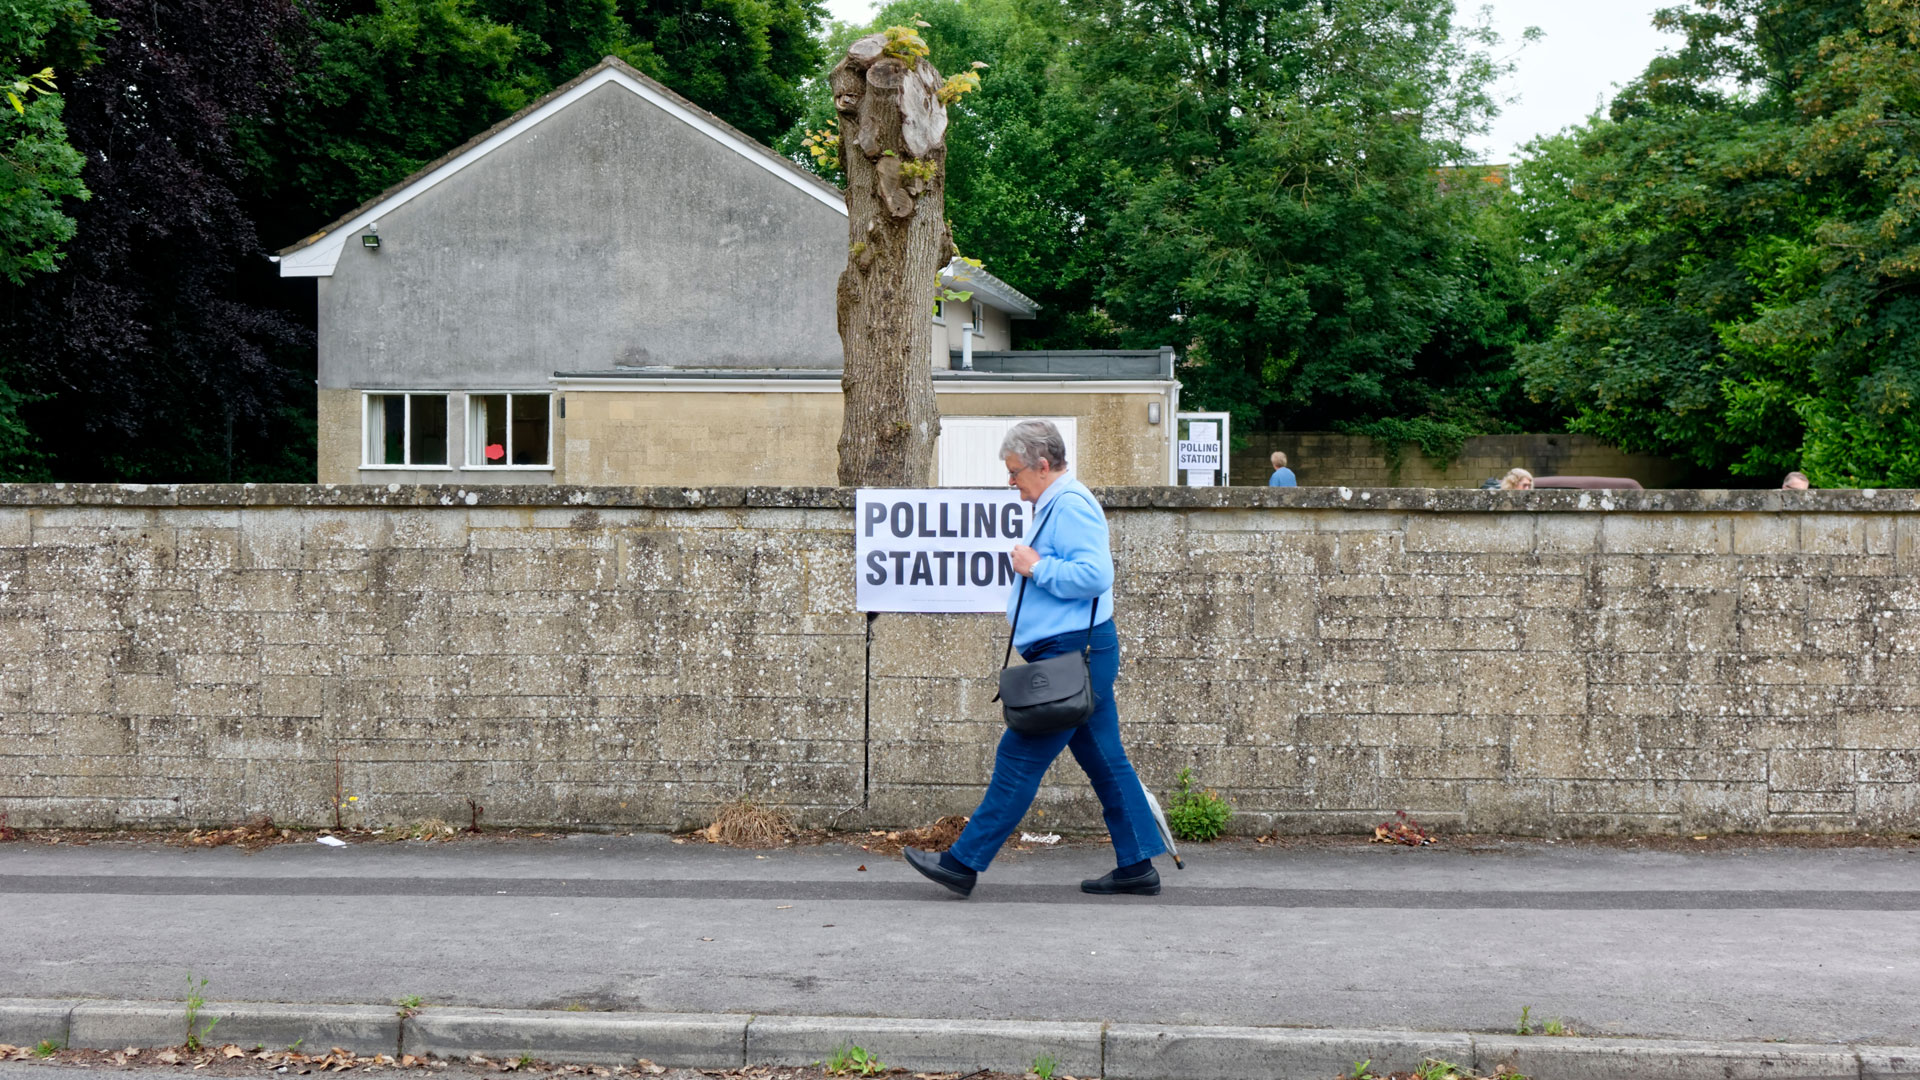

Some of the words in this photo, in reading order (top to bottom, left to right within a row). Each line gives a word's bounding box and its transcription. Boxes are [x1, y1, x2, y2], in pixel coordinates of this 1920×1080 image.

[1180, 443, 1218, 452] POLLING
[1180, 454, 1218, 463] STATION
[865, 501, 1023, 538] POLLING
